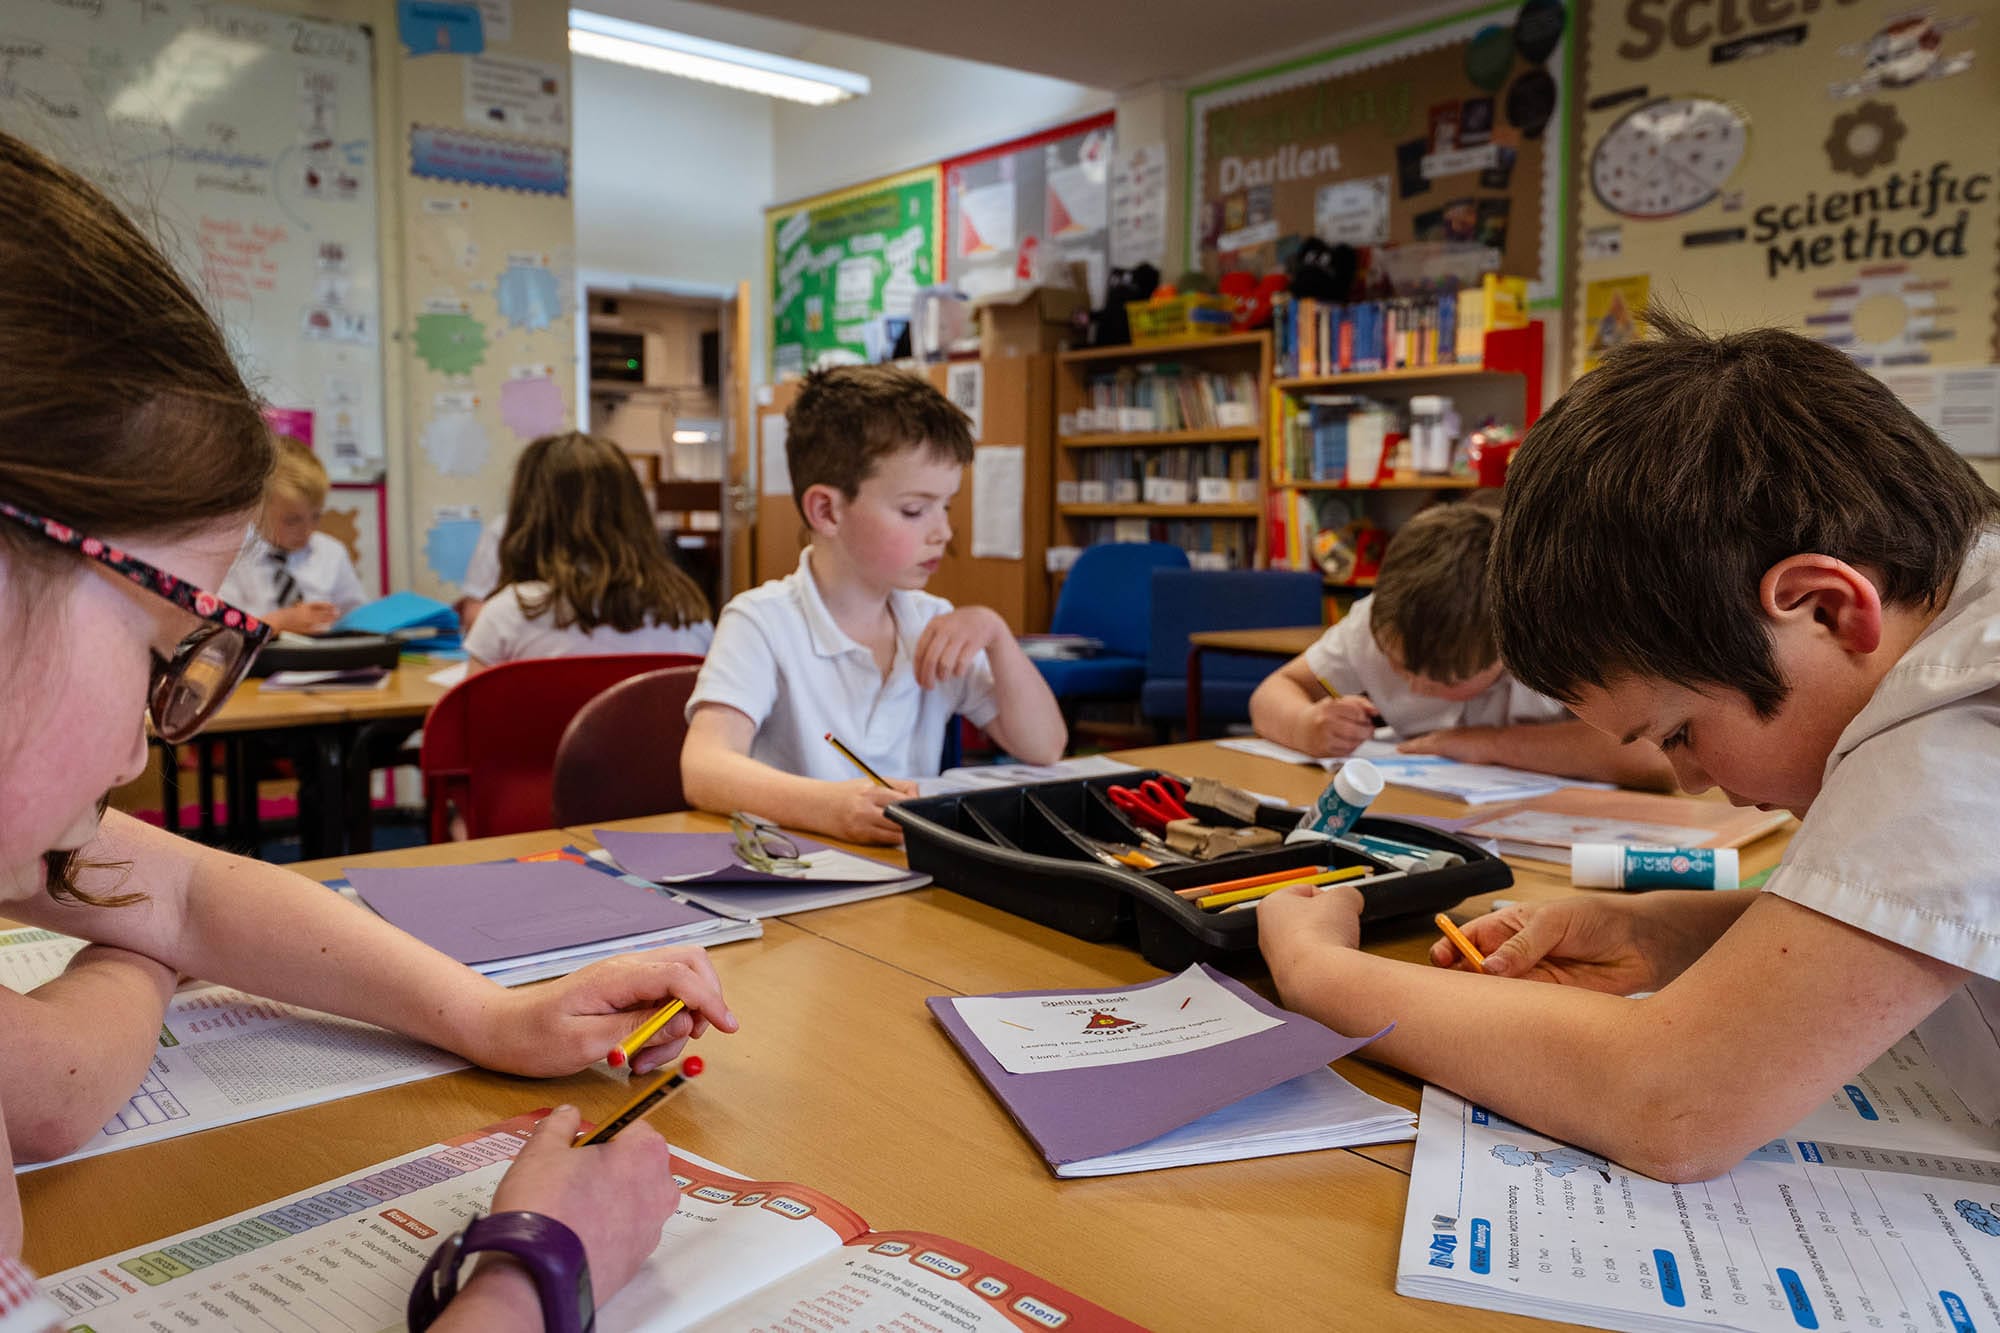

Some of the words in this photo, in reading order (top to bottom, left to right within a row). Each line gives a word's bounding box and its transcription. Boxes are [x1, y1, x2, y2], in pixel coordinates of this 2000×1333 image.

[1219, 144, 1342, 194] Darllen
[1754, 161, 1991, 243] Scientific
[1768, 211, 1968, 278] Method
[1041, 998, 1092, 1008] Spelling
[1096, 996, 1128, 1004] Book
[441, 1155, 469, 1168] predict
[1802, 1143, 1818, 1164] Revision
[699, 1187, 731, 1201] micro
[743, 1195, 760, 1203] en
[771, 1199, 806, 1216] ment
[1673, 1190, 1689, 1213] opposite
[265, 1212, 302, 1231] strengthen
[287, 1207, 319, 1222] lengthen
[387, 1210, 409, 1226] Base
[405, 1219, 430, 1237] Words
[369, 1222, 388, 1237] Write
[1474, 1223, 1490, 1248] Meanings
[1508, 1233, 1519, 1247] each
[168, 1247, 207, 1266] agreement
[1509, 1247, 1520, 1269] Match
[1538, 1247, 1550, 1260] two
[1688, 1242, 1703, 1263] revision
[295, 1263, 329, 1285] lengthen
[1639, 1261, 1651, 1277] paw
[1726, 1265, 1743, 1291] evening
[1811, 1259, 1829, 1283] revision
[1965, 1261, 1985, 1284] each
[272, 1272, 305, 1294] microfilm
[861, 1263, 882, 1276] Find
[884, 1270, 901, 1282] the
[901, 1278, 919, 1290] list
[917, 1286, 942, 1301] and
[940, 1297, 982, 1323] revision
[879, 1242, 903, 1253] pre
[920, 1254, 961, 1275] micro
[981, 1280, 1001, 1294] en
[1019, 1300, 1062, 1325] ment
[1699, 1285, 1715, 1302] Find
[248, 1281, 291, 1308] agreement
[850, 1270, 880, 1285] words
[893, 1286, 911, 1298] the
[911, 1295, 940, 1312] word
[938, 1309, 978, 1333] search
[1831, 1306, 1848, 1322] Find
